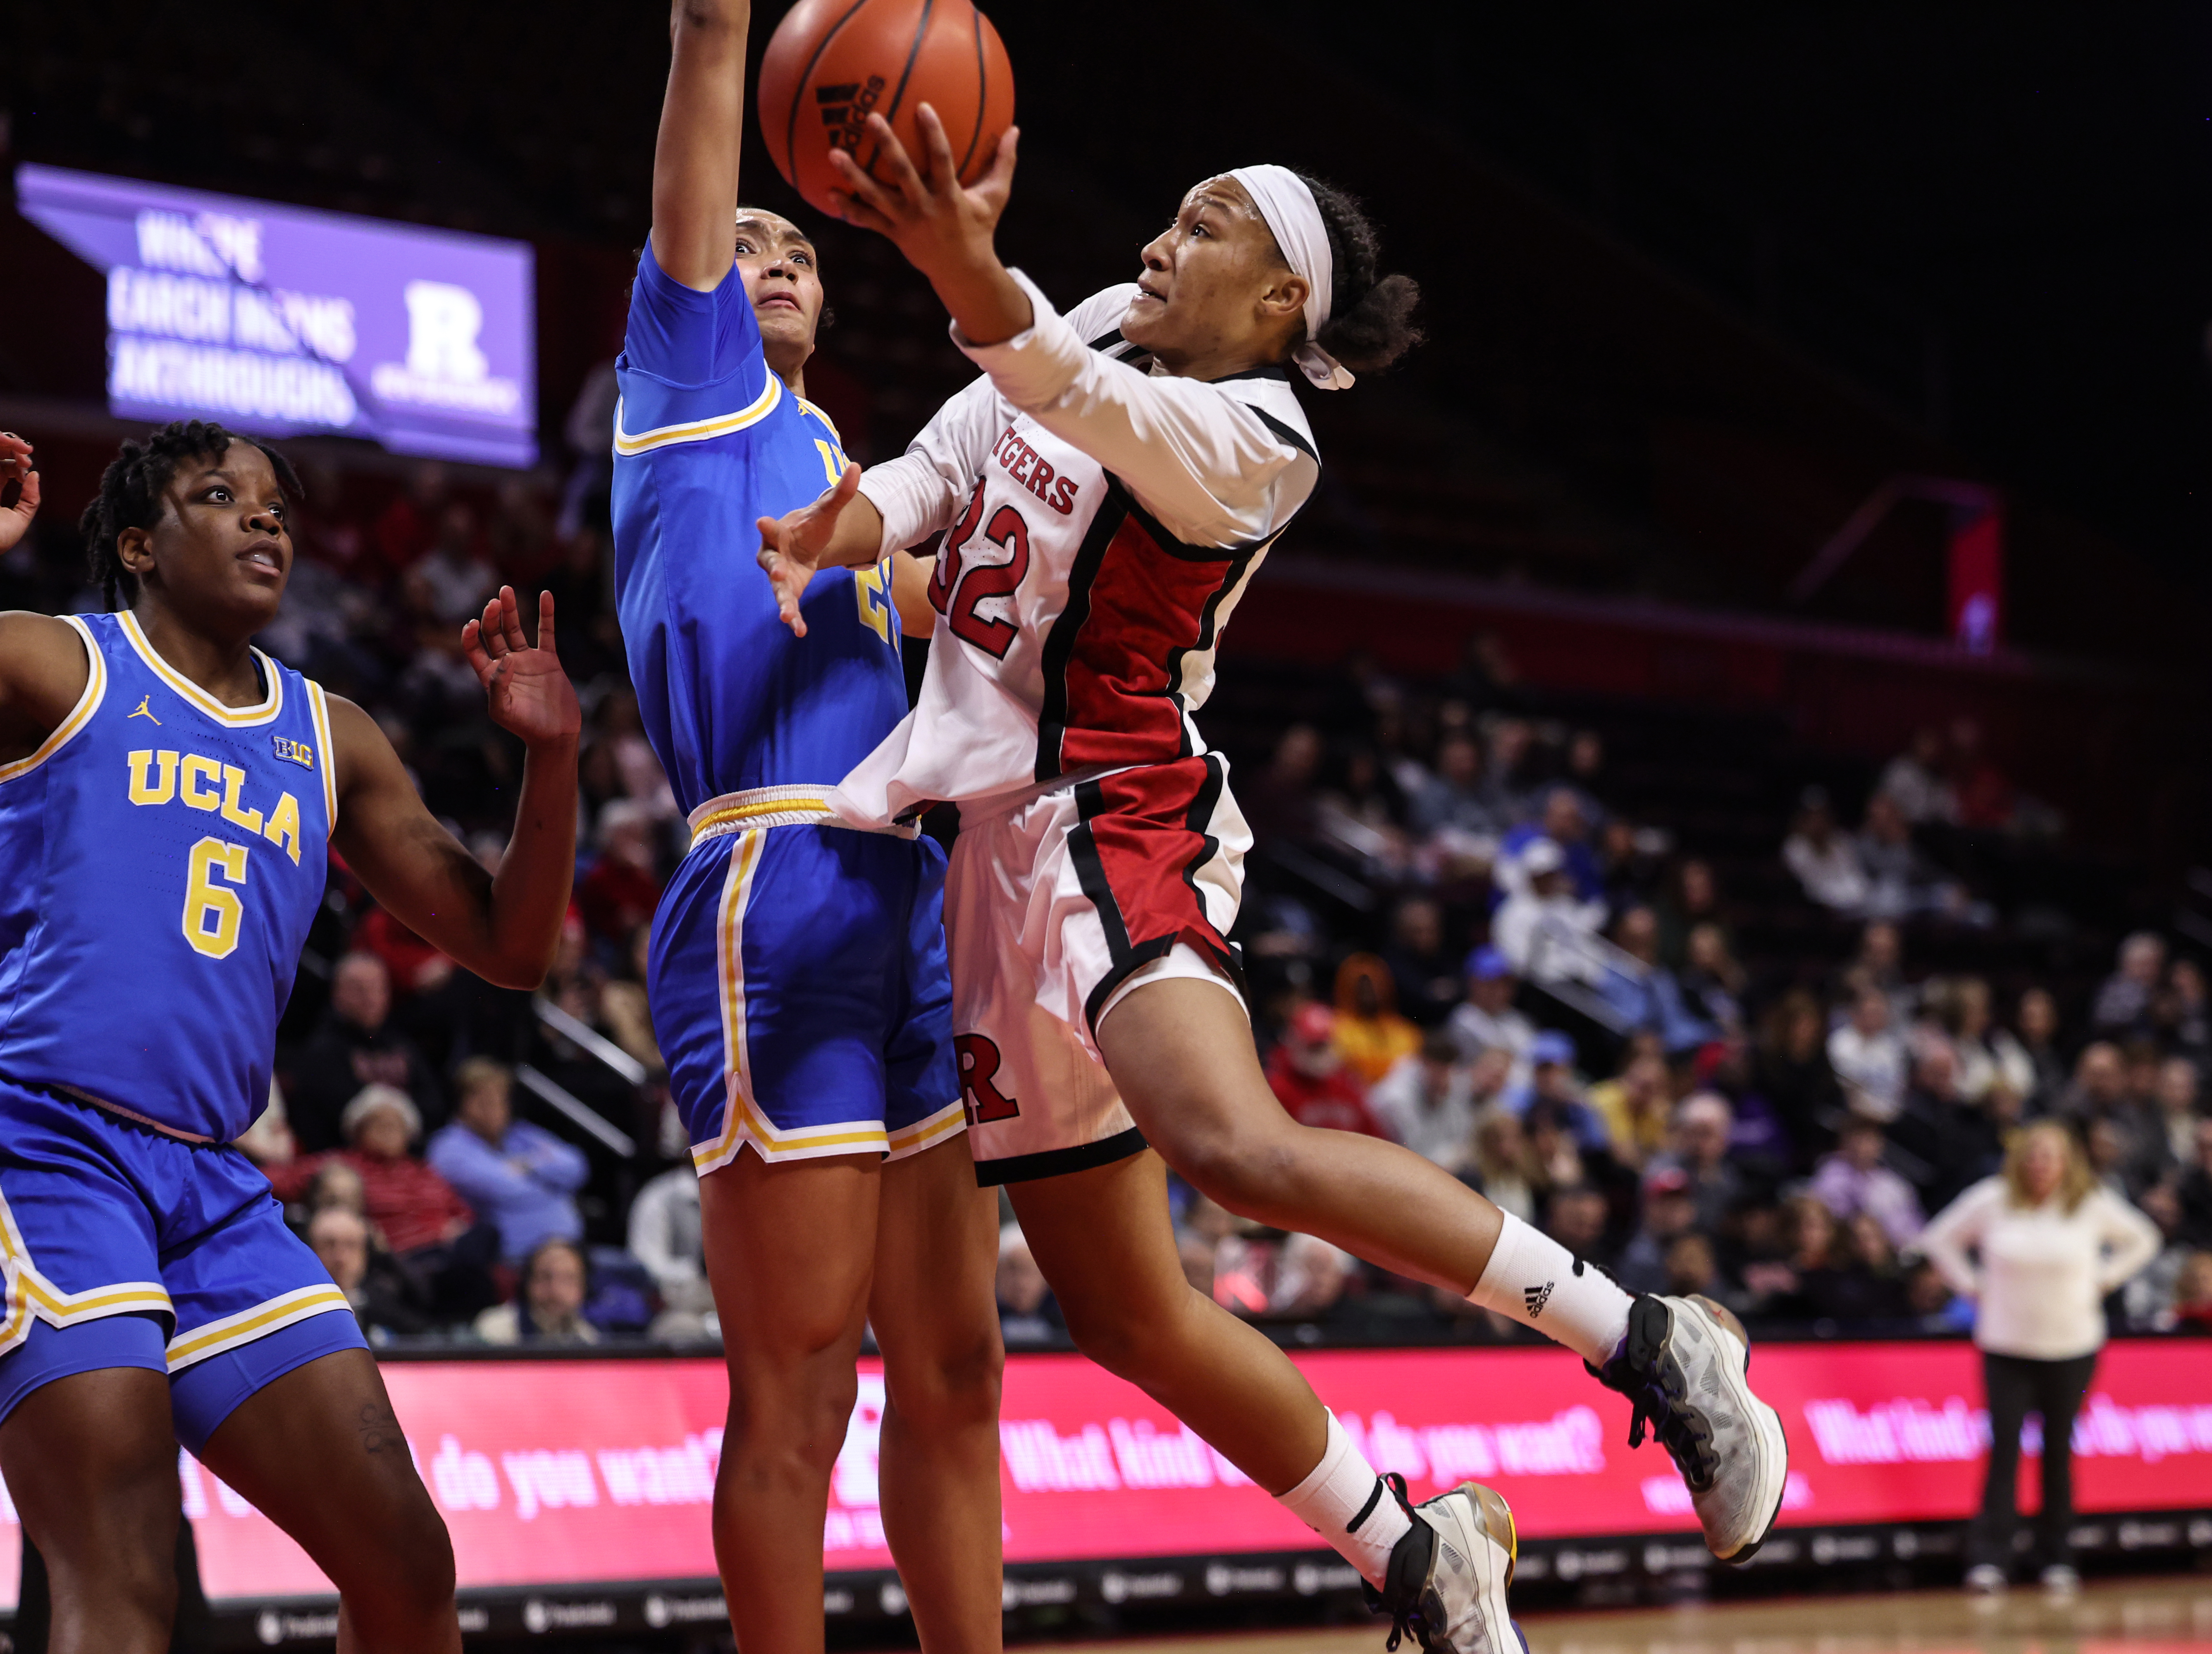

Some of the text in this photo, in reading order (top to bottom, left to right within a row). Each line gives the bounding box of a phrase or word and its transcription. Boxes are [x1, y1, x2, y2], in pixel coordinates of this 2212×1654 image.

[928, 476, 1029, 661] 32
[128, 749, 301, 867] UCLA
[182, 836, 249, 960] 6
[953, 1033, 1020, 1126] R
[1530, 1280, 1554, 1318] adidas
